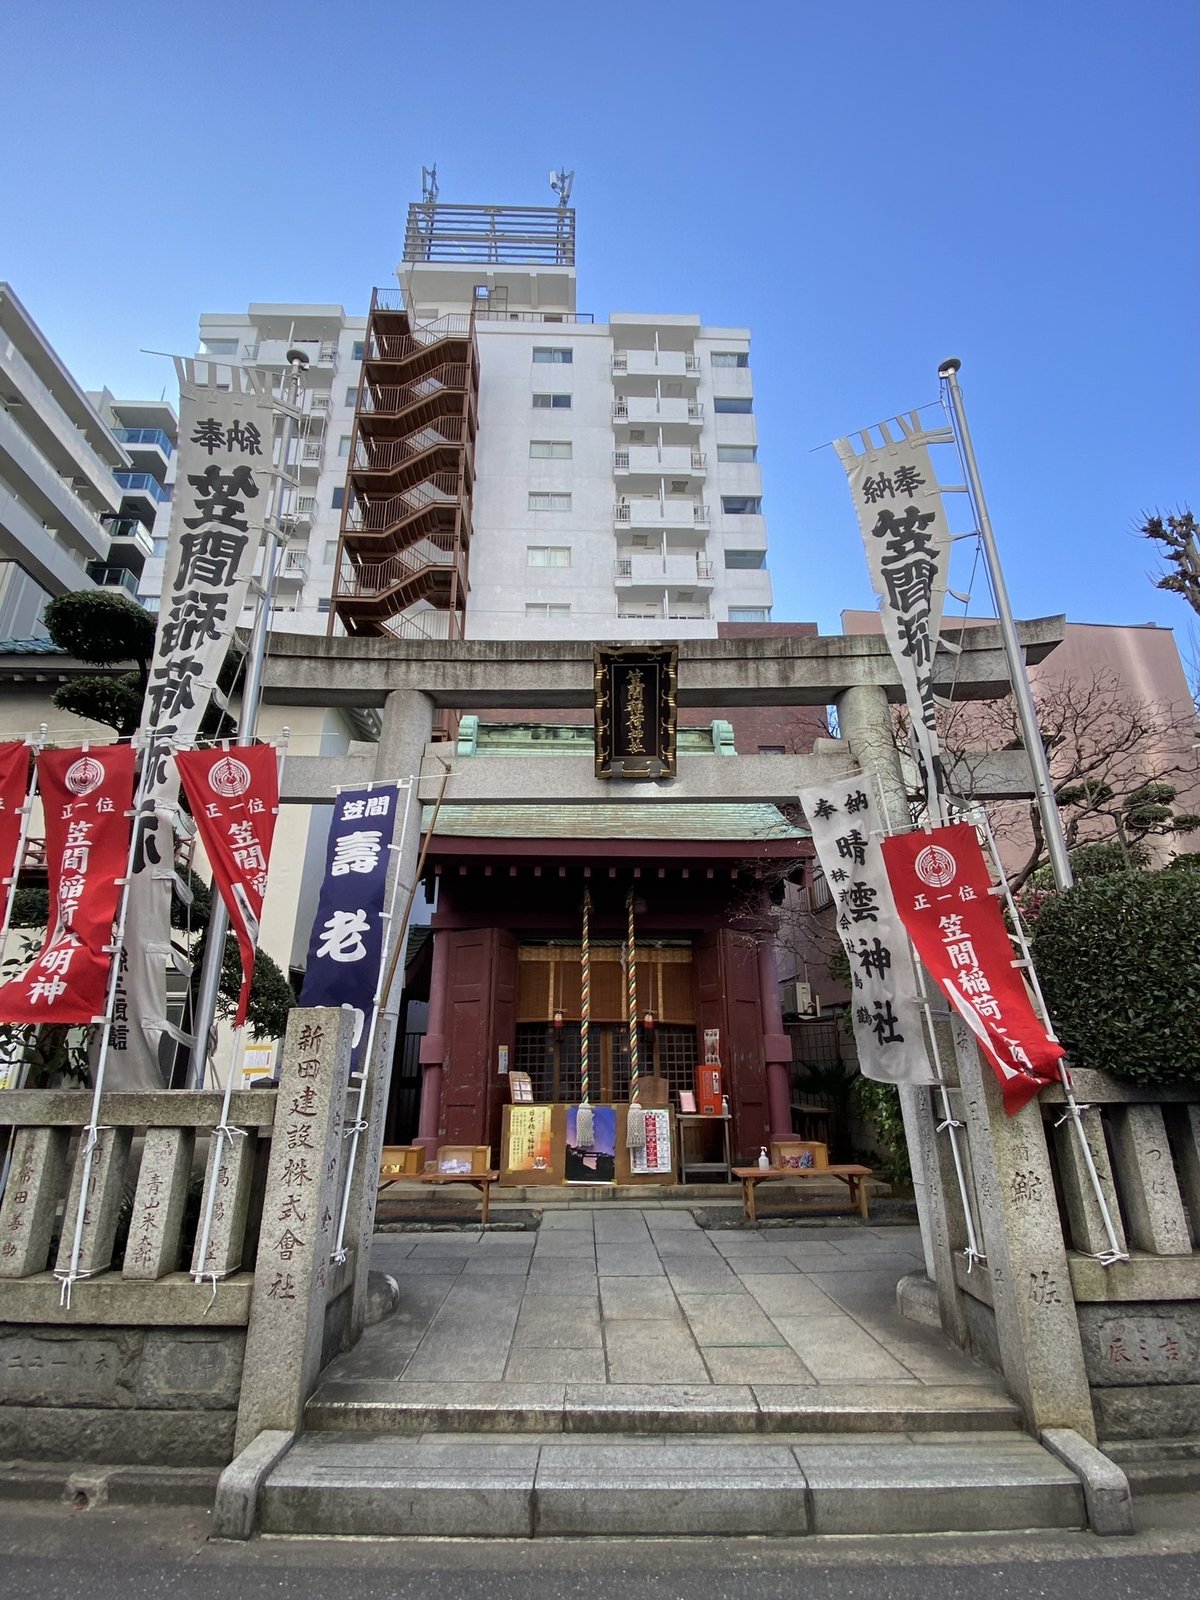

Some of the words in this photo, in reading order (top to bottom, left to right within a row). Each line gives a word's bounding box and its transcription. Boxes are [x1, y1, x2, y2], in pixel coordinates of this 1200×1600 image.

[61, 797, 115, 820] 正一位
[204, 797, 267, 819] 正一位
[331, 795, 390, 821] 笠間
[813, 789, 868, 821] 奉納
[913, 885, 978, 911] 正一位
[835, 828, 905, 1047] 晴雲神社
[132, 1172, 165, 1269] 青山米太郎
